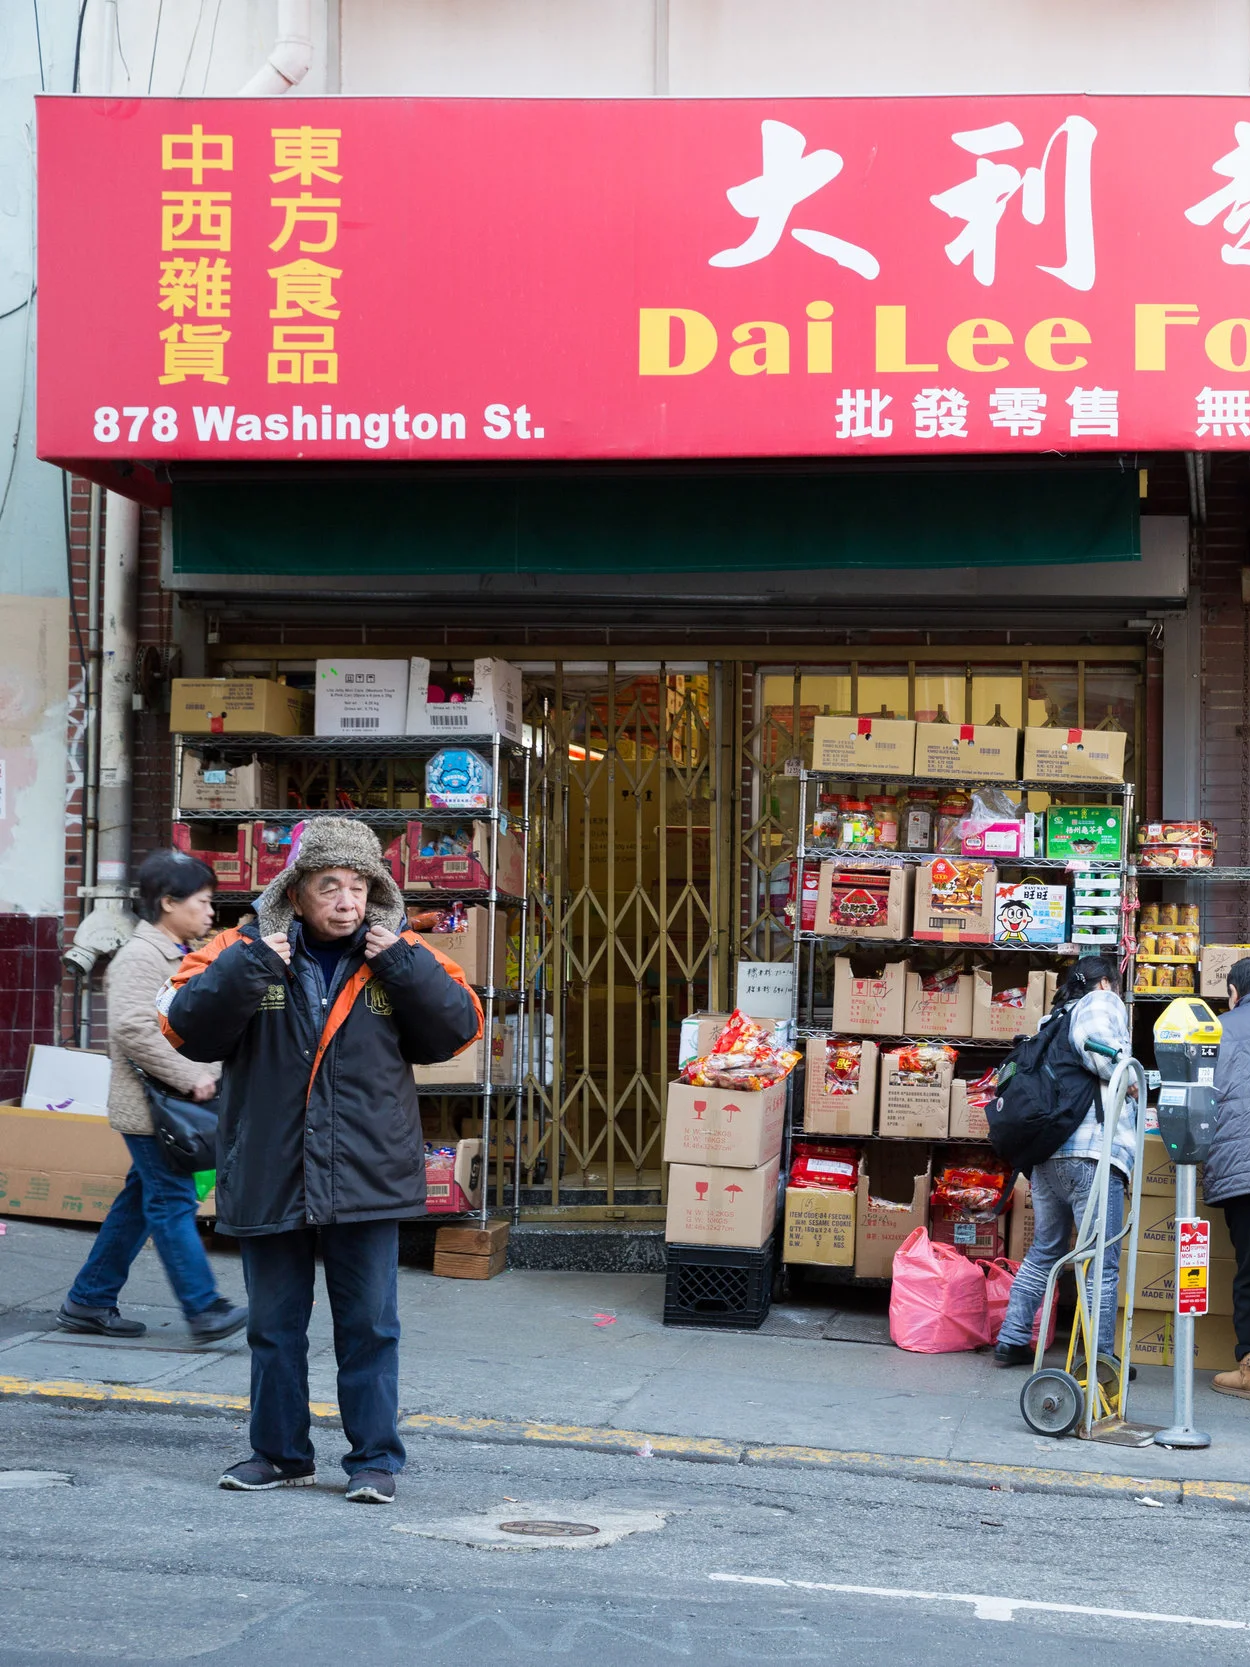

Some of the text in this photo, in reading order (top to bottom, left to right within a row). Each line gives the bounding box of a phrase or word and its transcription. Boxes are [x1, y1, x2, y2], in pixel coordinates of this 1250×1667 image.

[158, 124, 233, 385] 中西雜貨
[267, 126, 343, 384] 東方食品
[638, 301, 834, 375] Dai
[875, 306, 1093, 372] Lee
[835, 386, 1119, 438] 批發零售
[93, 404, 545, 449] 878 Washington St.
[1024, 890, 1048, 900] 旺旺
[1146, 1176, 1169, 1184] MADE
[1144, 1232, 1176, 1242] MADE IN
[1142, 1290, 1163, 1298] MADE
[1166, 1292, 1174, 1300] IN
[1135, 1344, 1157, 1353] MADE
